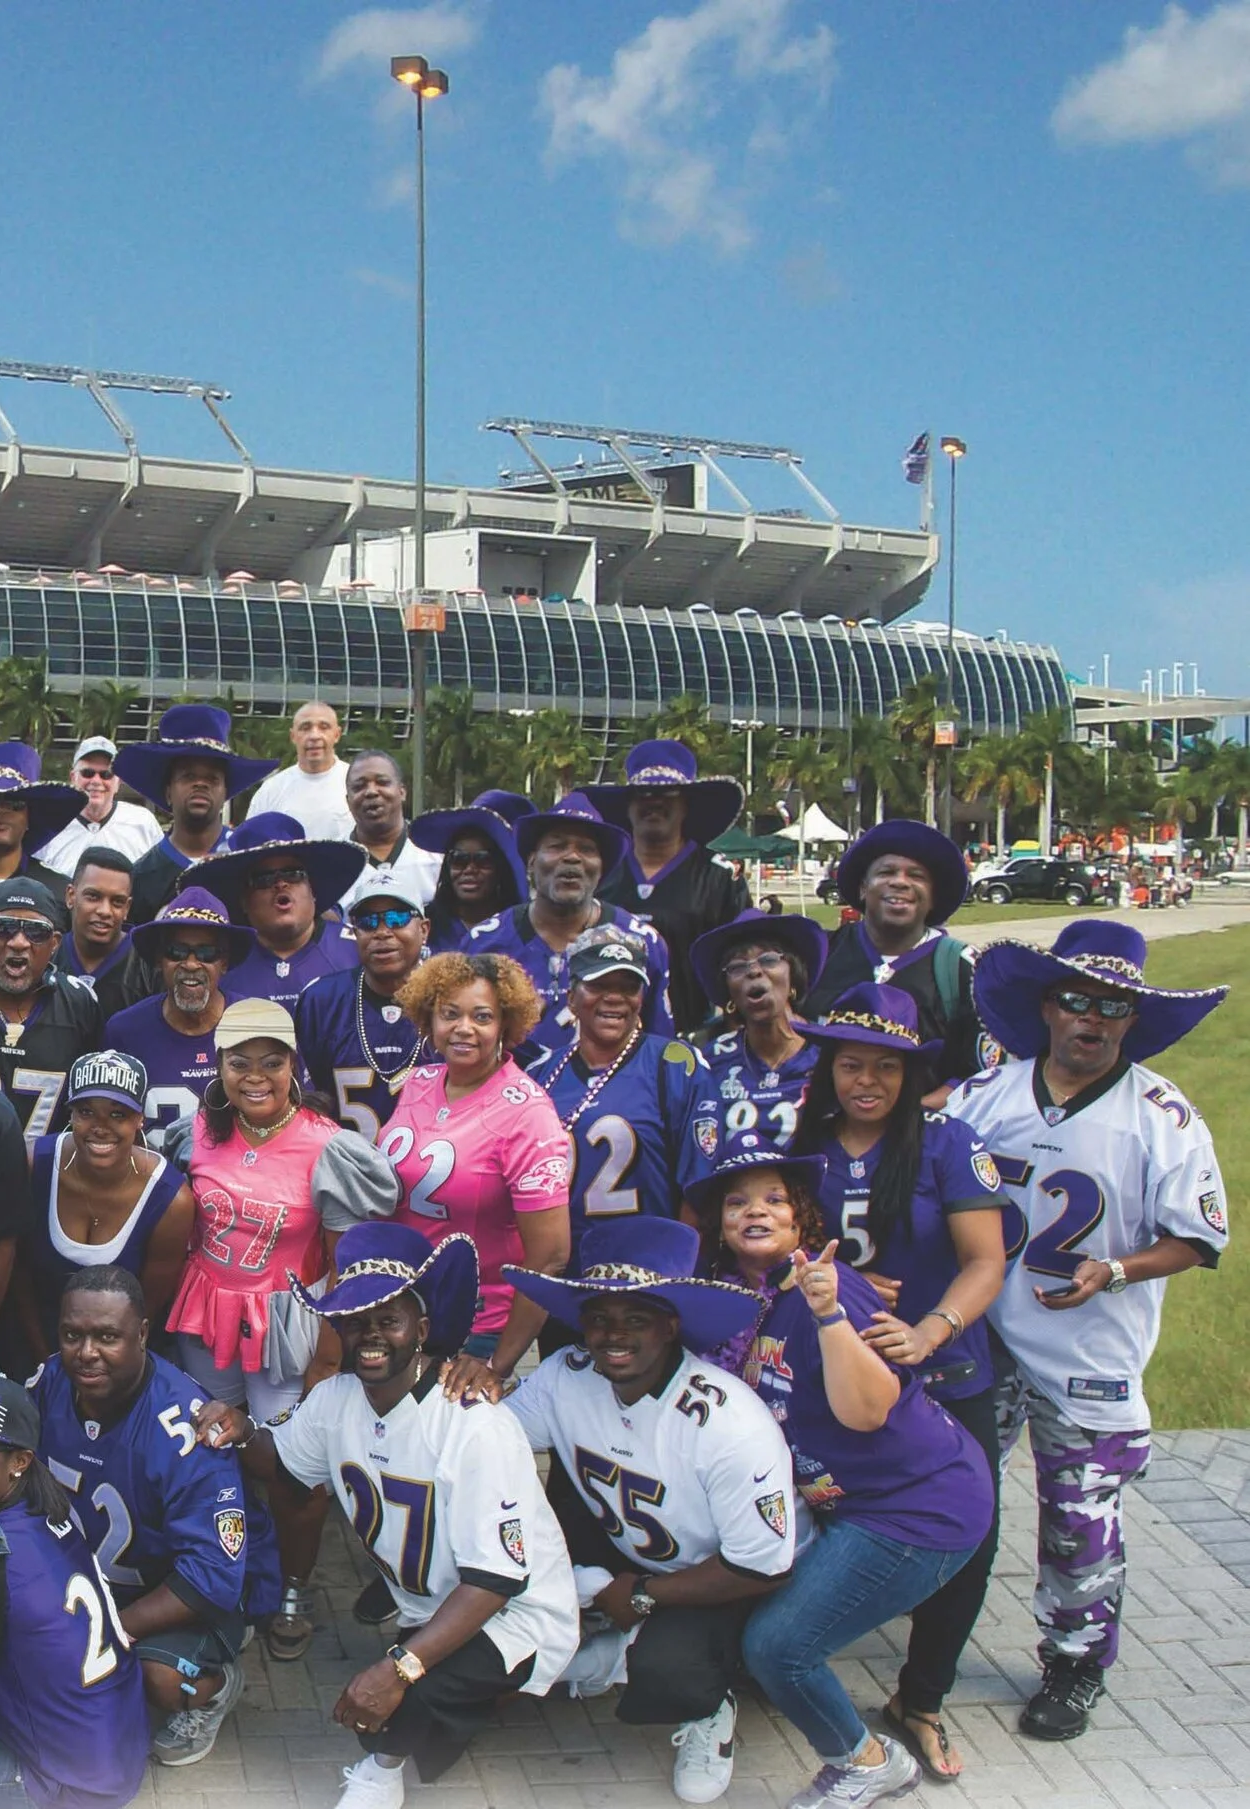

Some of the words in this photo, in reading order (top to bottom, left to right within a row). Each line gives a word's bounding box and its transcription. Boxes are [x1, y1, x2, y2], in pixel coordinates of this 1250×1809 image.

[75, 1063, 142, 1096] BALTIMORE
[502, 1078, 544, 1105] 82
[200, 1189, 287, 1270] 27
[676, 1374, 727, 1428] 55
[574, 1446, 679, 1562] 55
